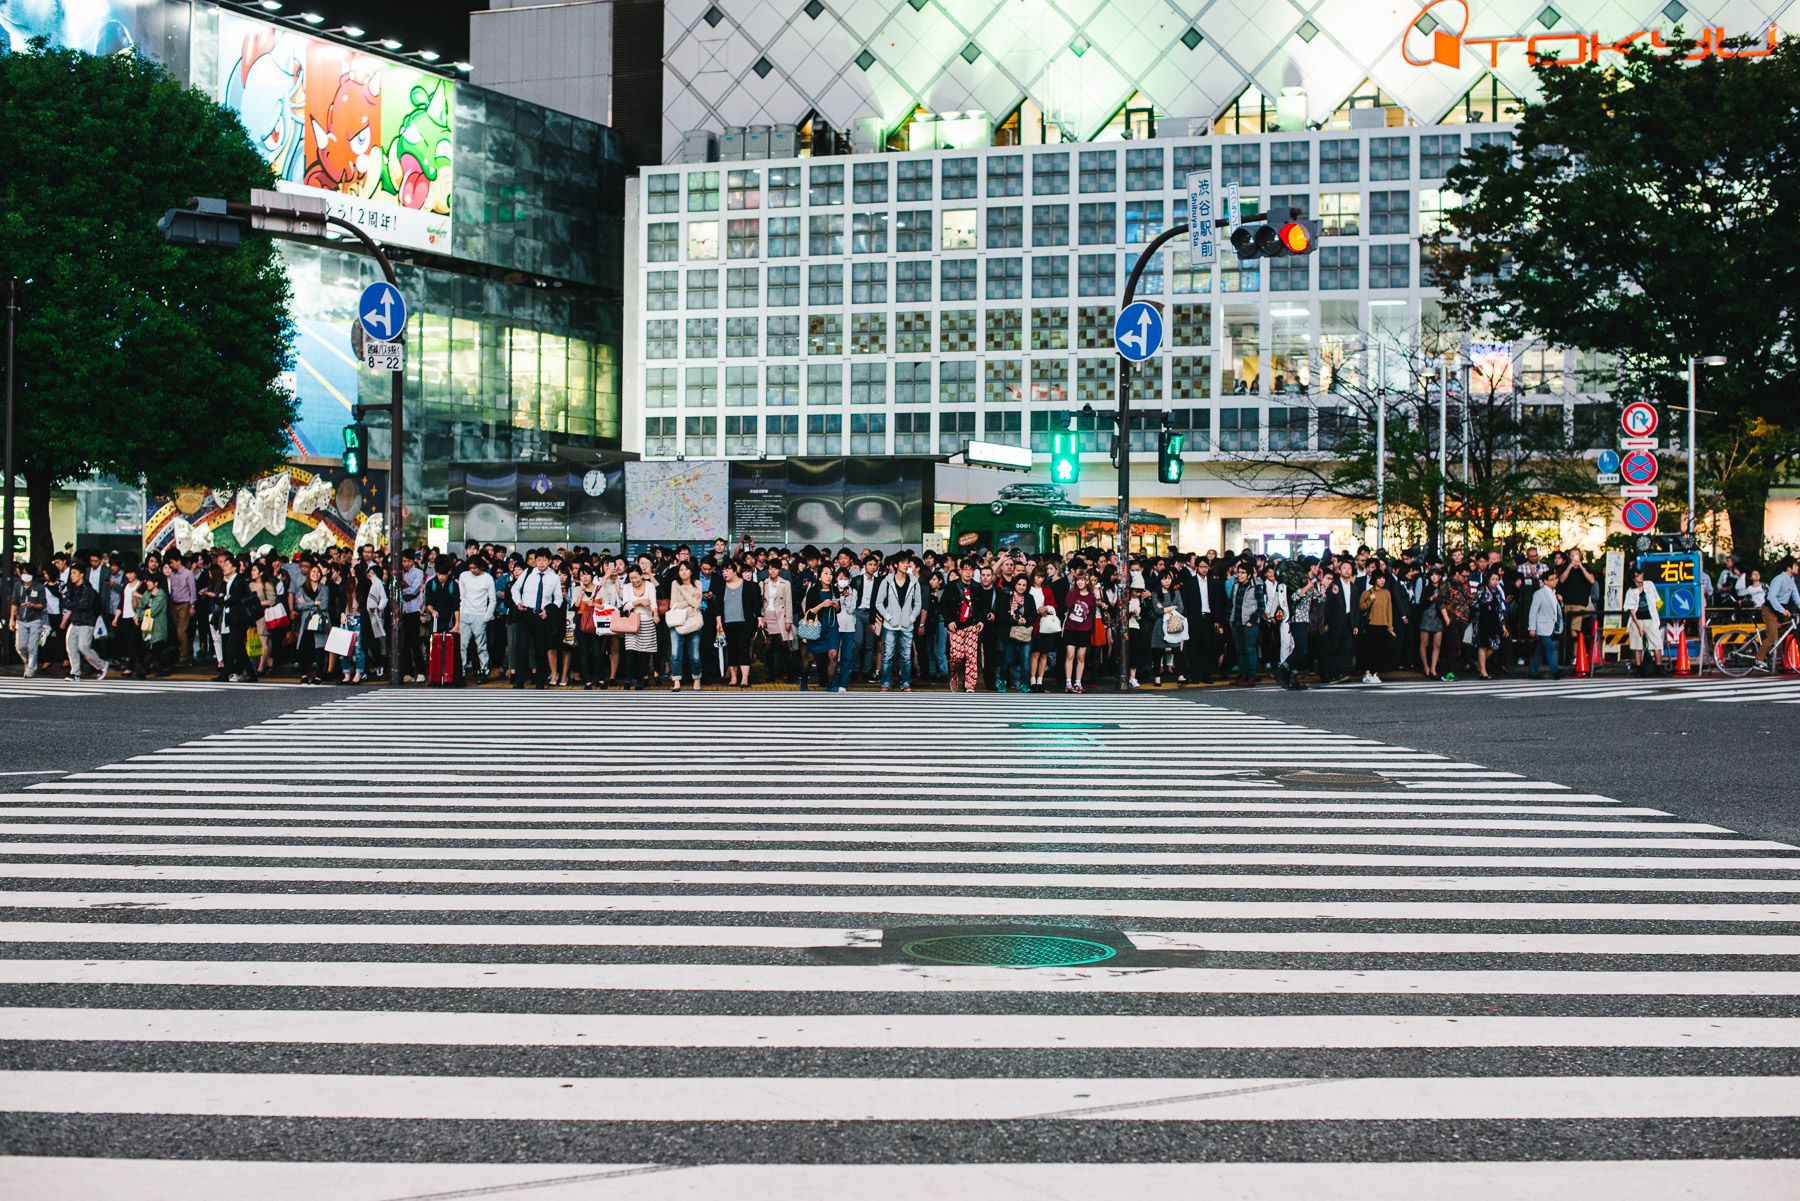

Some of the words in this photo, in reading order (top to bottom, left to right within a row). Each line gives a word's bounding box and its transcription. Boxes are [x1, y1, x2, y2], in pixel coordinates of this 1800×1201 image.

[1464, 24, 1778, 68] TOKYU
[1198, 178, 1213, 257] 渋谷駅前
[368, 356, 399, 369] 8-22
[1660, 560, 1695, 582] 右に
[1073, 603, 1084, 616] DC
